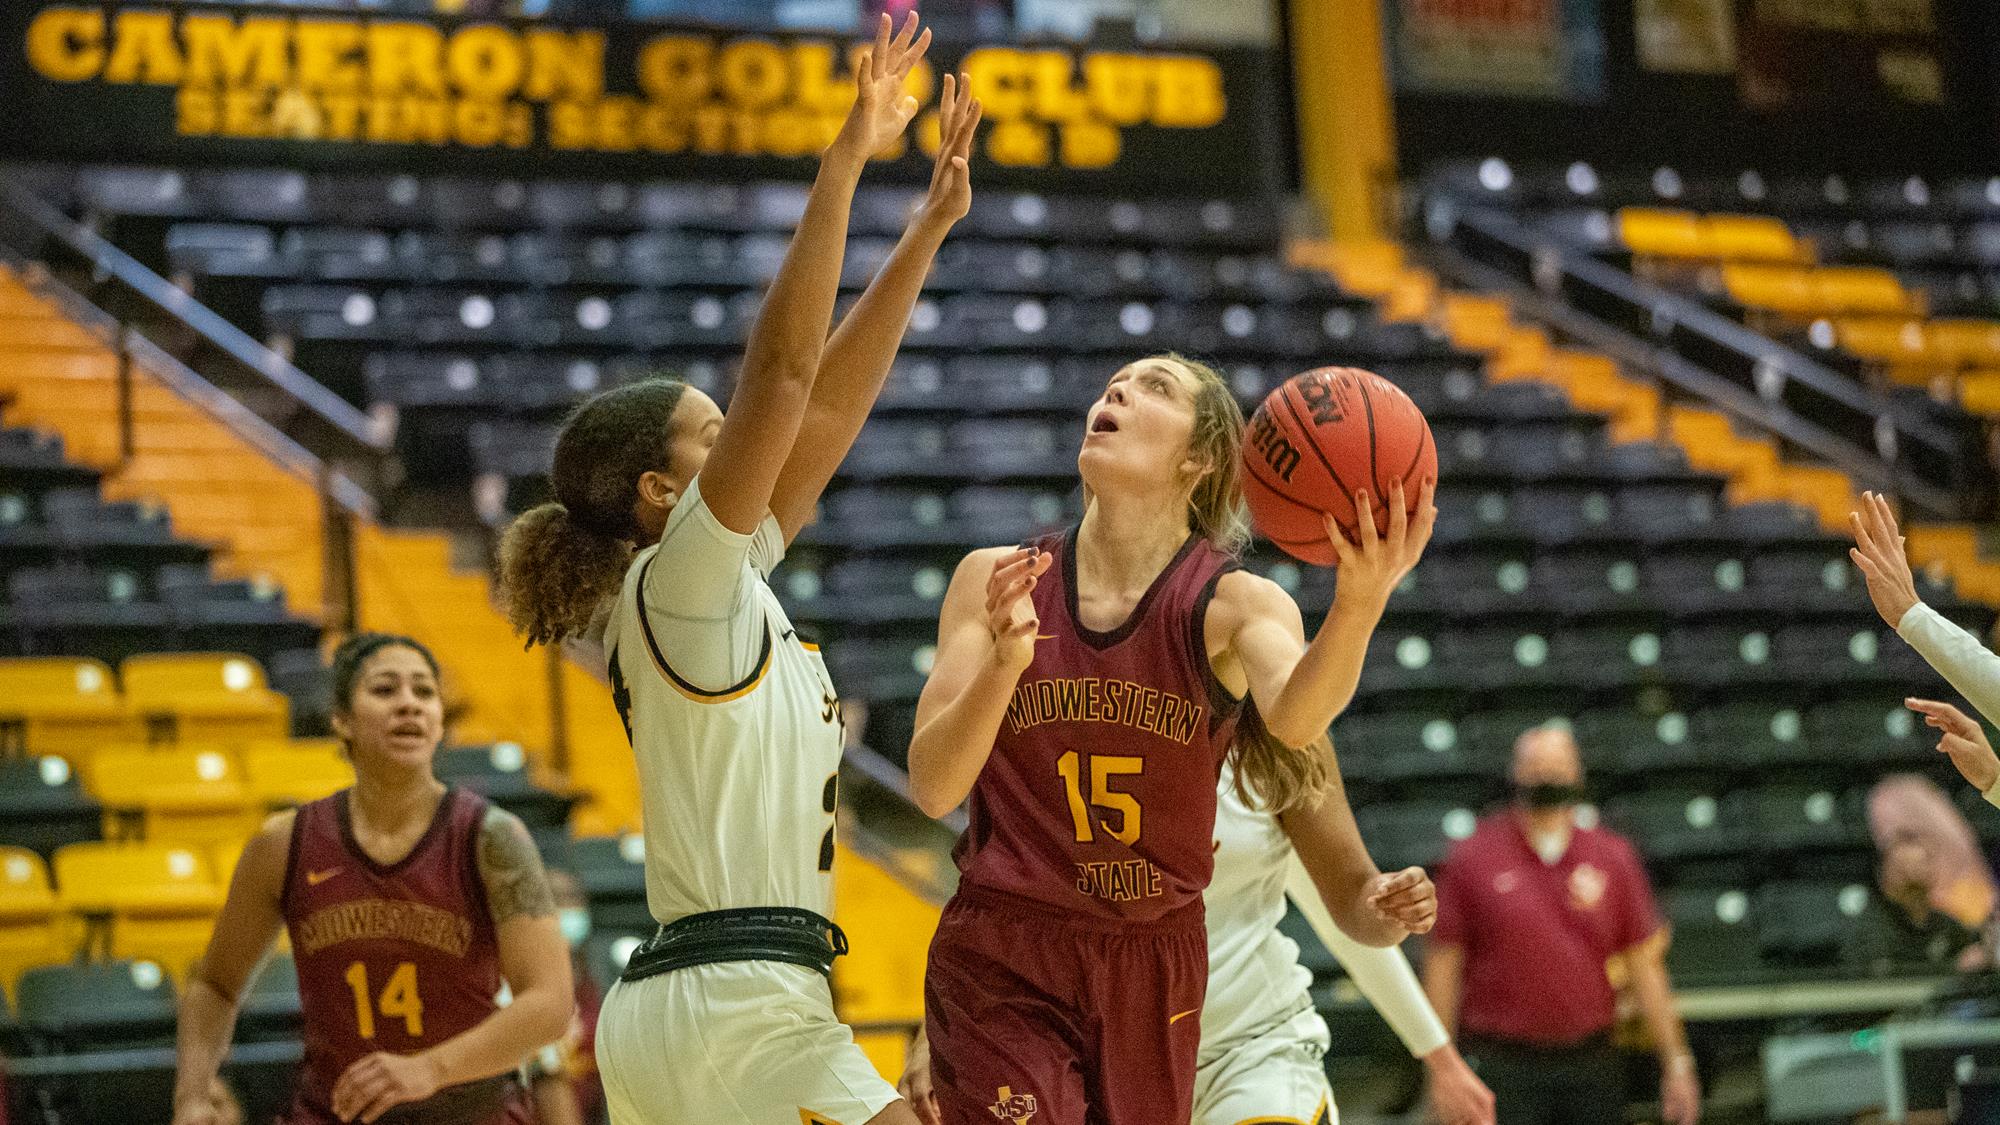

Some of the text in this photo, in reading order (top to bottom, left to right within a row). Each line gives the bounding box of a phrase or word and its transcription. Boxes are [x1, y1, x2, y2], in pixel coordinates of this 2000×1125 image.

[26, 9, 606, 100] CAMERON
[962, 46, 1225, 128] CLUB
[175, 87, 533, 148] SEATING:
[1006, 677, 1202, 746] MIDWESTERN
[1057, 750, 1143, 847] 15
[1074, 858, 1162, 902] STATE
[345, 960, 424, 1039] 14
[995, 1094, 1037, 1119] MSU
